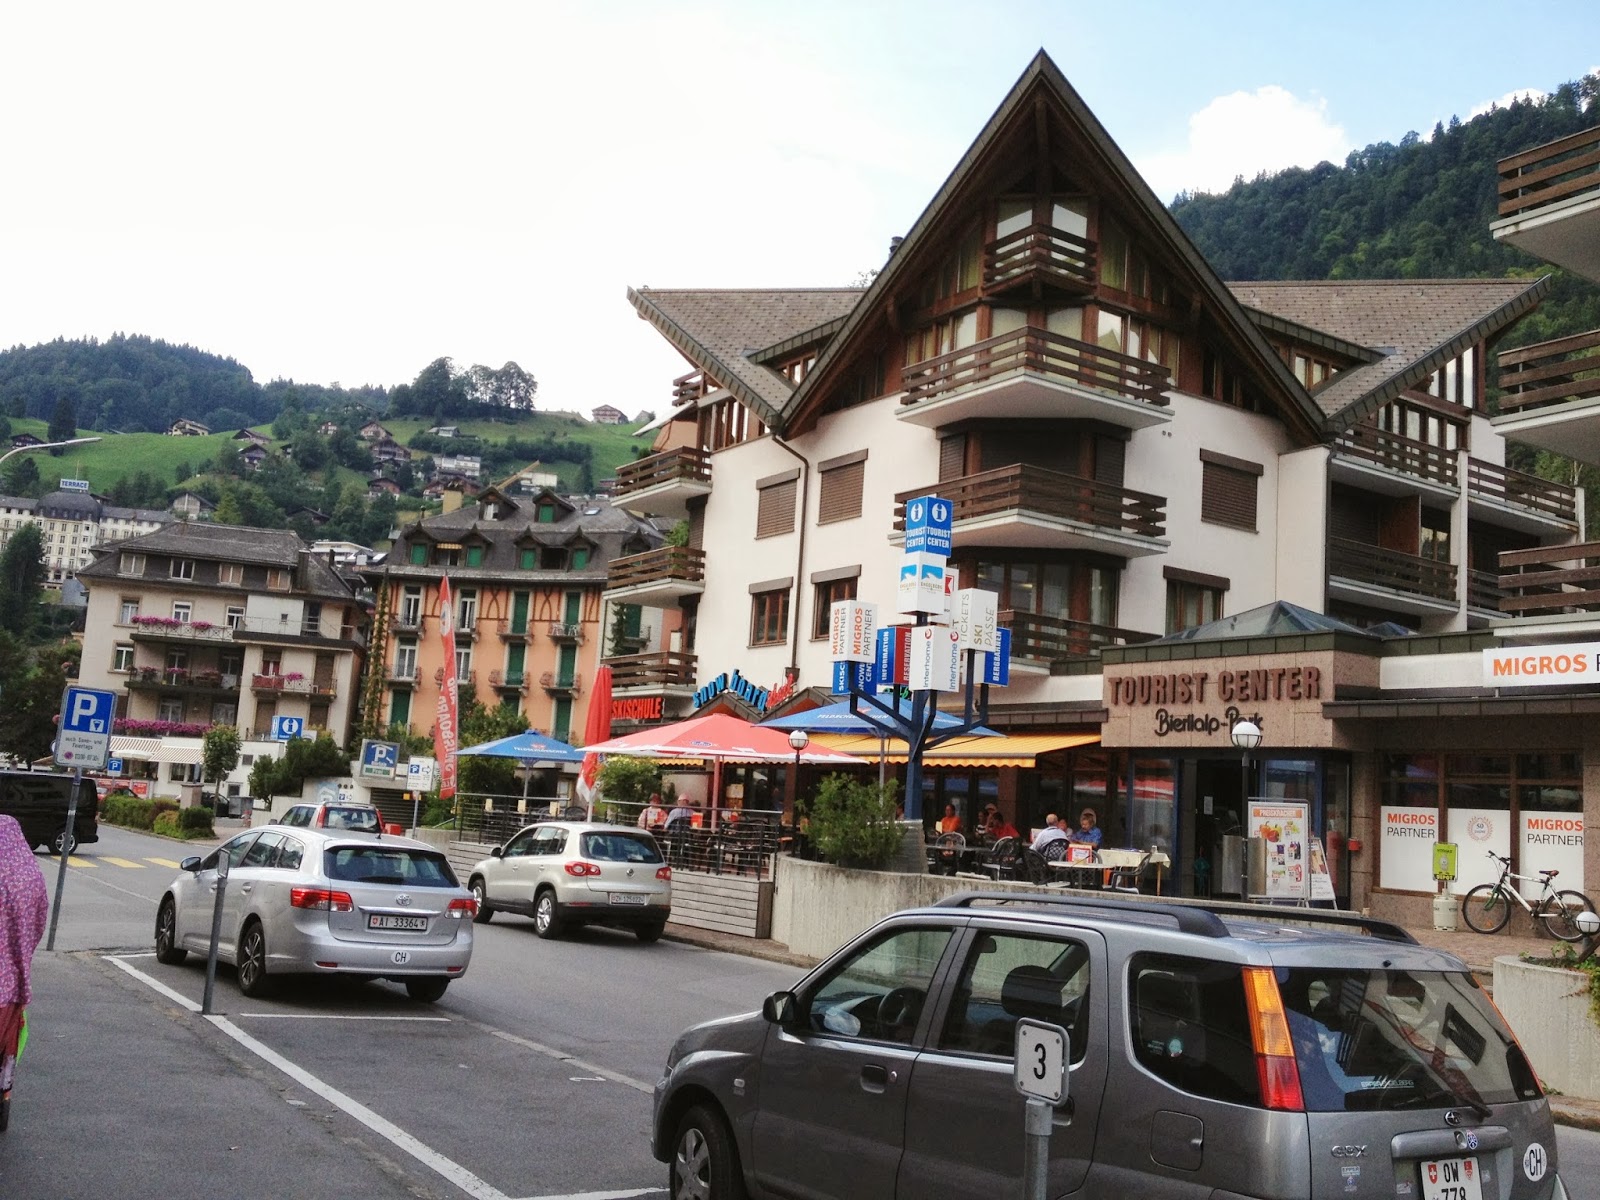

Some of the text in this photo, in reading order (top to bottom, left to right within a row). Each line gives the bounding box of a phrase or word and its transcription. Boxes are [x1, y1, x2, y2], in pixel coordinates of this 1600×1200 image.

[907, 527, 926, 538] TOURIST
[907, 537, 924, 548] CENTER
[927, 538, 949, 548] CENTER
[928, 528, 950, 538] TOURIST
[960, 593, 969, 643] TICKETS
[985, 607, 995, 647] PASSE
[832, 608, 840, 655] MIGROS
[853, 607, 863, 655] MIGROS
[863, 608, 872, 656] PARTNER
[974, 624, 983, 645] SKI
[881, 631, 889, 681] INFORMATION
[903, 631, 911, 681] RESERVATION
[1492, 654, 1588, 677] MIGROS
[1108, 666, 1322, 707] TOURIST CENTER
[611, 697, 662, 720] SKISCHULE
[1387, 813, 1435, 826] MIGROS
[1527, 818, 1584, 832] MIGROS
[1387, 827, 1435, 839] PARTNER
[1527, 834, 1584, 846] PARTNER
[379, 917, 419, 928] AI 33364
[394, 951, 407, 963] CH
[1033, 1043, 1046, 1080] 3
[1443, 1162, 1459, 1183] OW
[1528, 1149, 1543, 1177] CH
[1441, 1186, 1467, 1200] 778
